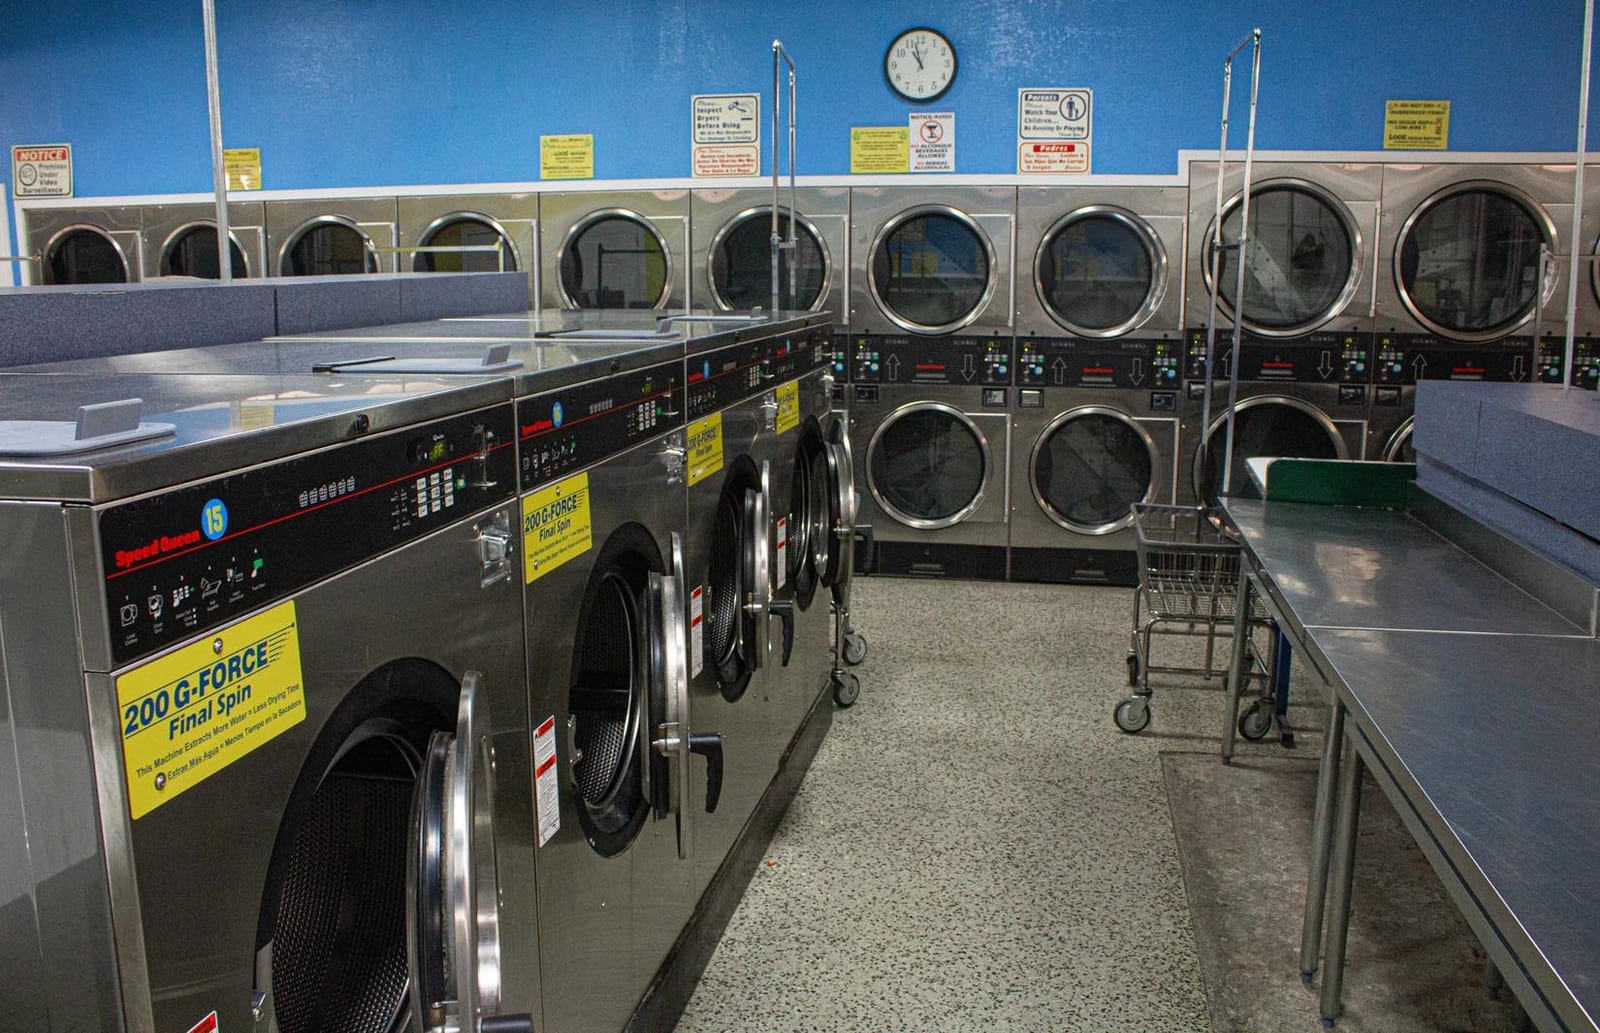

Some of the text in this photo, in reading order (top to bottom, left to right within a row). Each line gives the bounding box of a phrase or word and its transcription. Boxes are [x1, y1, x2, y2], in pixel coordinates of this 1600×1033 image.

[897, 49, 905, 57] 10
[906, 40, 913, 48] 11
[917, 36, 925, 44] 12
[919, 85, 923, 93] 6
[20, 150, 64, 160] NOTICE
[206, 505, 224, 535] 15
[525, 495, 577, 532] 200 G-FORCE
[539, 523, 556, 542] Final
[557, 518, 570, 535] Spin
[115, 530, 200, 568] Speed Queen
[125, 640, 268, 736] 200 G-FORCE
[169, 684, 251, 740] Final Spin
[136, 765, 152, 777] This
[154, 748, 183, 768] Machine
[185, 732, 211, 751] Extracts
[213, 723, 229, 735] More
[230, 712, 247, 728] Water
[253, 702, 267, 714] Less
[268, 691, 286, 706] Drying
[287, 683, 299, 694] Time
[203, 747, 219, 760] Agua
[225, 732, 244, 746] Menos
[245, 721, 264, 735] Tiempo
